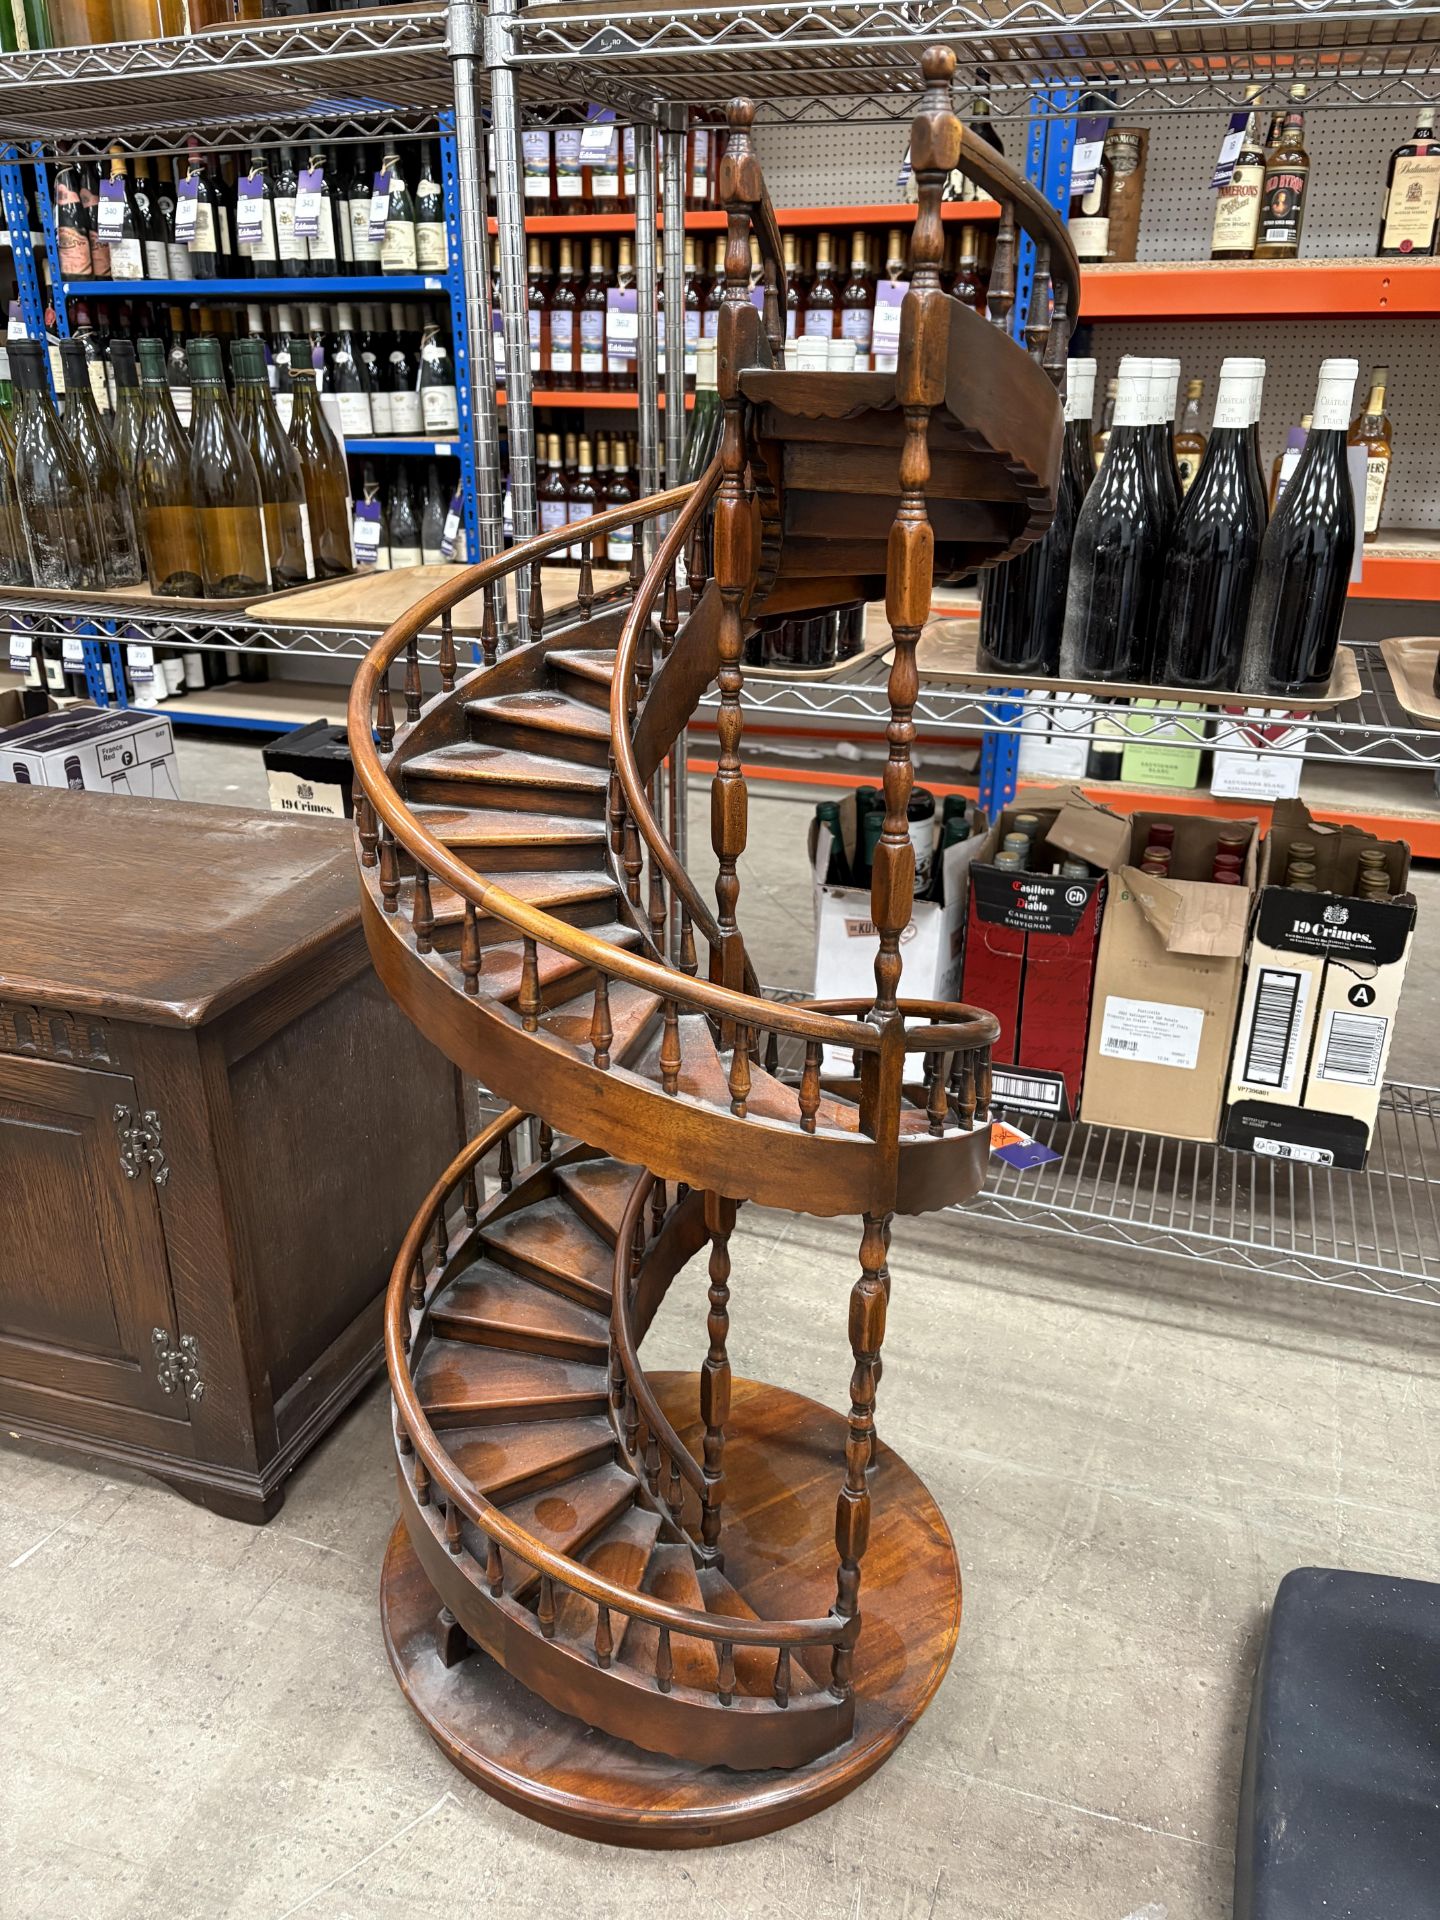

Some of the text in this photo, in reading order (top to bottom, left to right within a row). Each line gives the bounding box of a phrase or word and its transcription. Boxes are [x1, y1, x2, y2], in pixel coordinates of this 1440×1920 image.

[294, 222, 318, 230] Eddisons
[102, 744, 124, 755] France
[103, 752, 116, 762] Red
[281, 798, 292, 809] 19
[1012, 880, 1055, 896] Casillero
[1068, 890, 1084, 902] Ch
[1016, 898, 1048, 912] Diablo
[1008, 909, 1050, 922] CABERNET
[1004, 917, 1052, 930] SAUVIGNON
[1292, 920, 1311, 934] 19
[1352, 987, 1369, 1004] A
[1020, 1107, 1038, 1116] Weight
